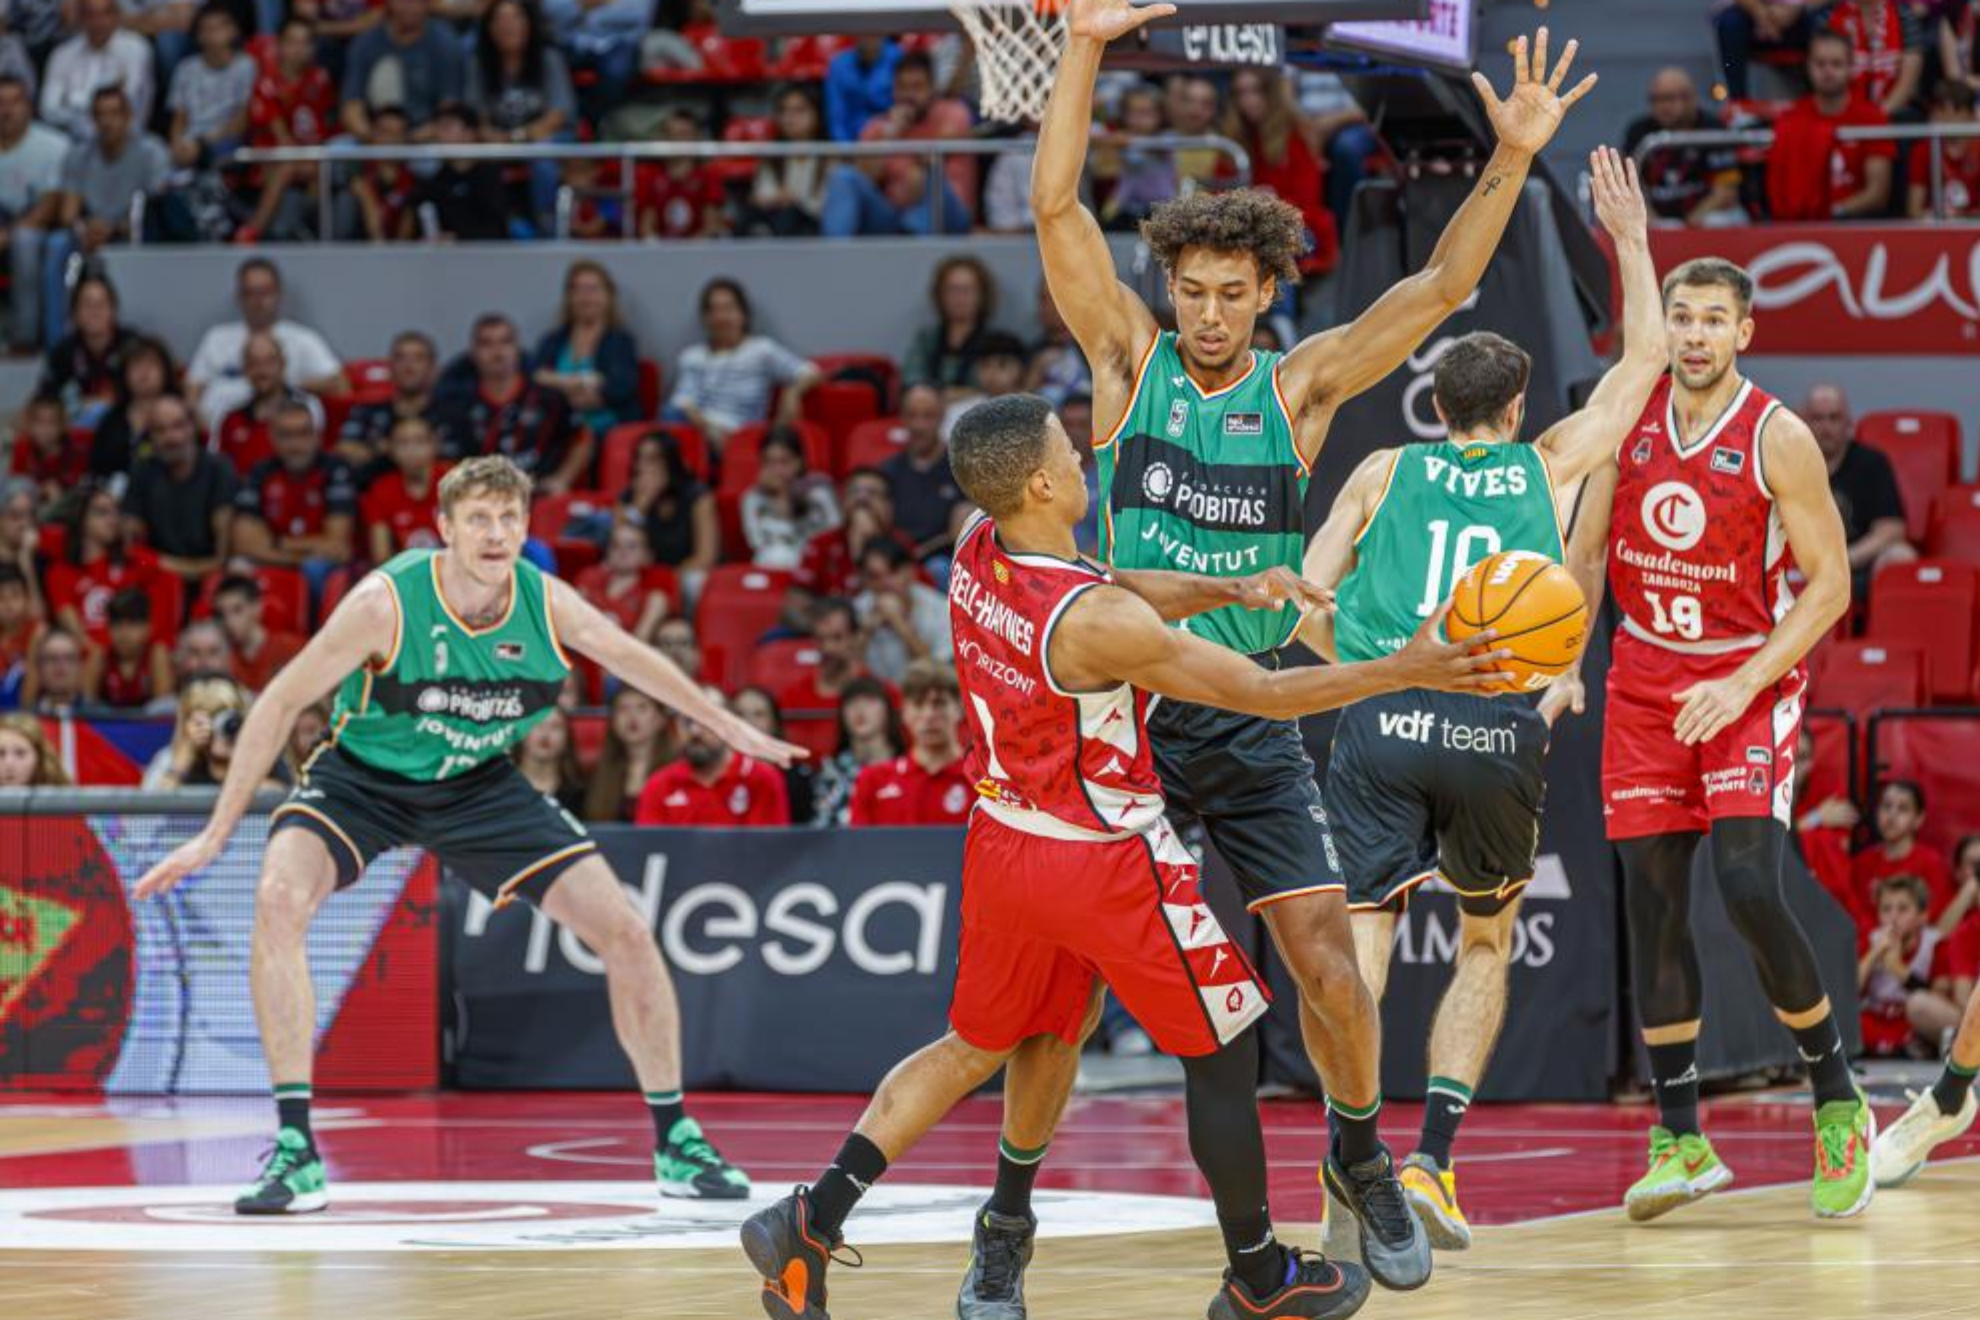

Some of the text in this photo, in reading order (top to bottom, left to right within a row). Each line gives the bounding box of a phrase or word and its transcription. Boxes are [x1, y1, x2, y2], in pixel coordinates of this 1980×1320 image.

[1424, 456, 1528, 498] VIVES
[1175, 483, 1266, 526] POBITAS
[1141, 521, 1260, 573] JVENTUT
[1616, 537, 1736, 583] Casademont
[1641, 570, 1702, 594] ZARAGOZA
[950, 561, 1035, 658] BELL-HAYNES
[1643, 590, 1703, 641] 19
[1379, 700, 1517, 754] vdf team
